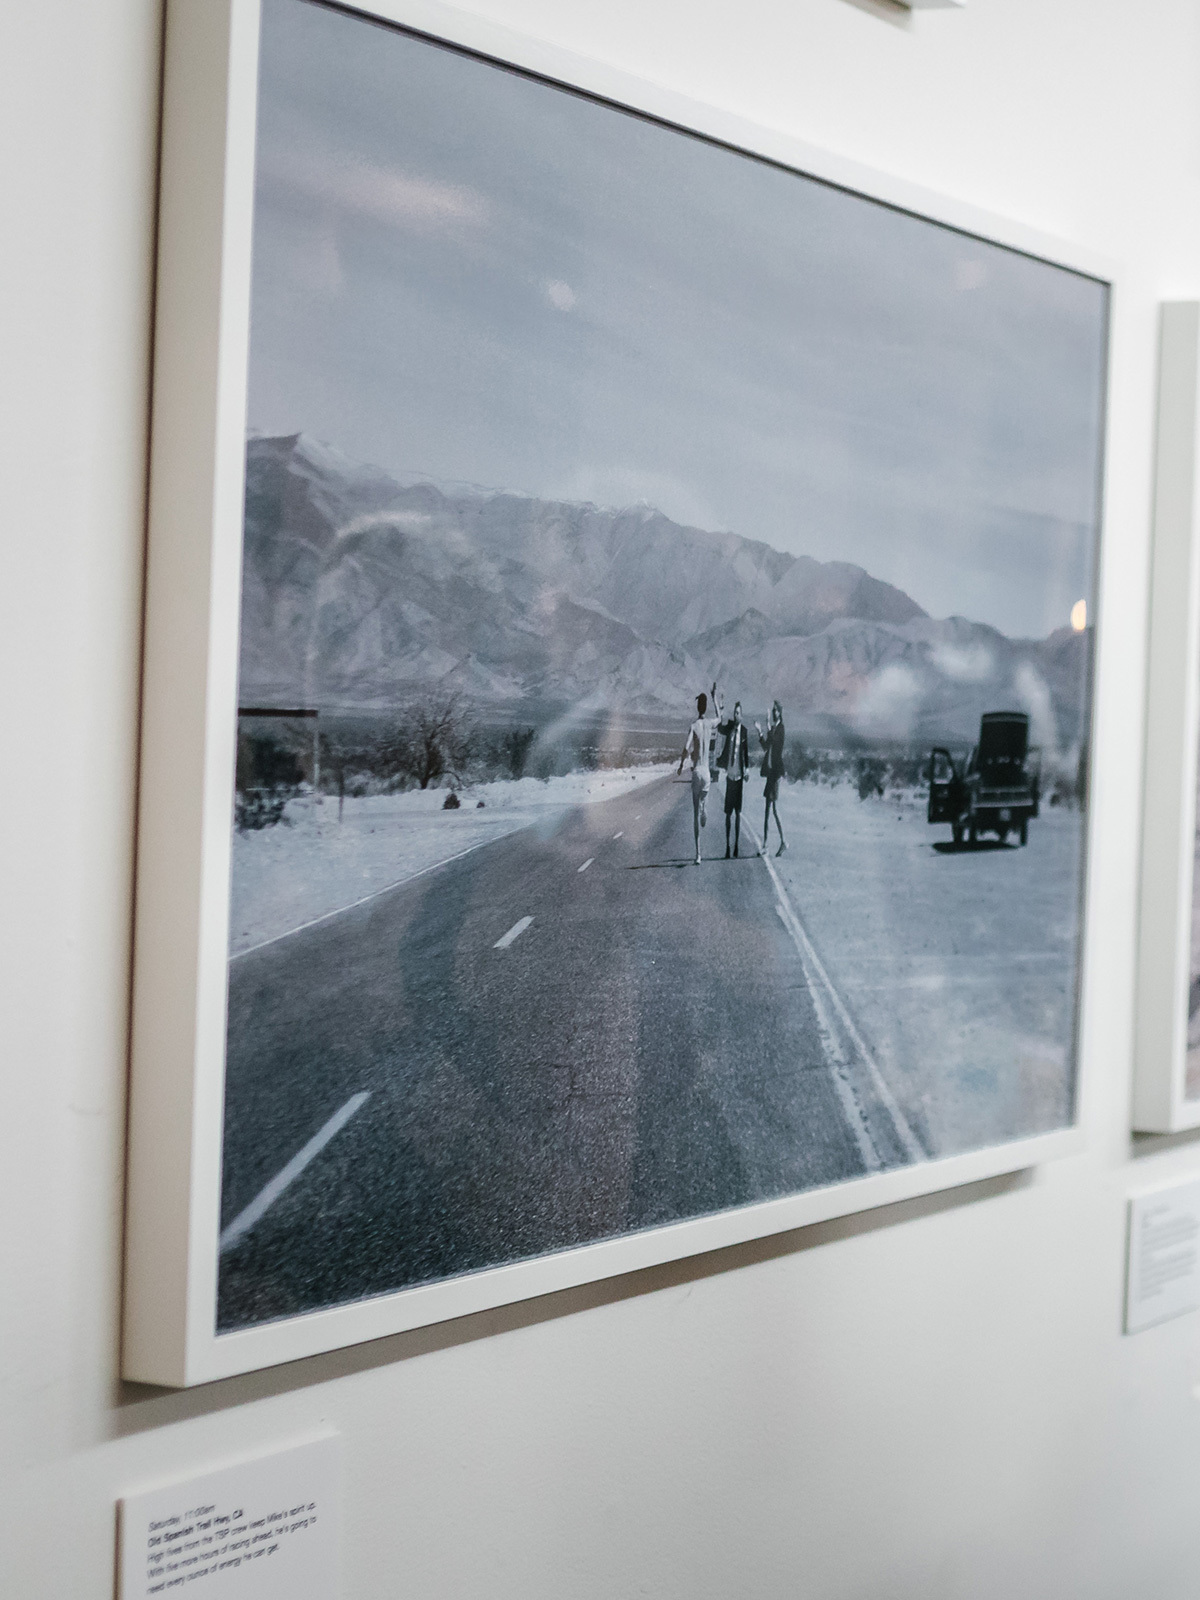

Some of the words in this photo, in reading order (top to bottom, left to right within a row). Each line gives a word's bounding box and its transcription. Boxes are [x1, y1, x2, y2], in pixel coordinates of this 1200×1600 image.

[147, 1536, 161, 1548] Old
[163, 1526, 194, 1543] Spanish
[196, 1518, 212, 1531] Trail
[183, 1540, 200, 1551] from
[201, 1536, 213, 1545] the
[180, 1556, 198, 1567] more
[199, 1548, 219, 1561] hours
[220, 1544, 228, 1555] of
[210, 1562, 217, 1573] of
